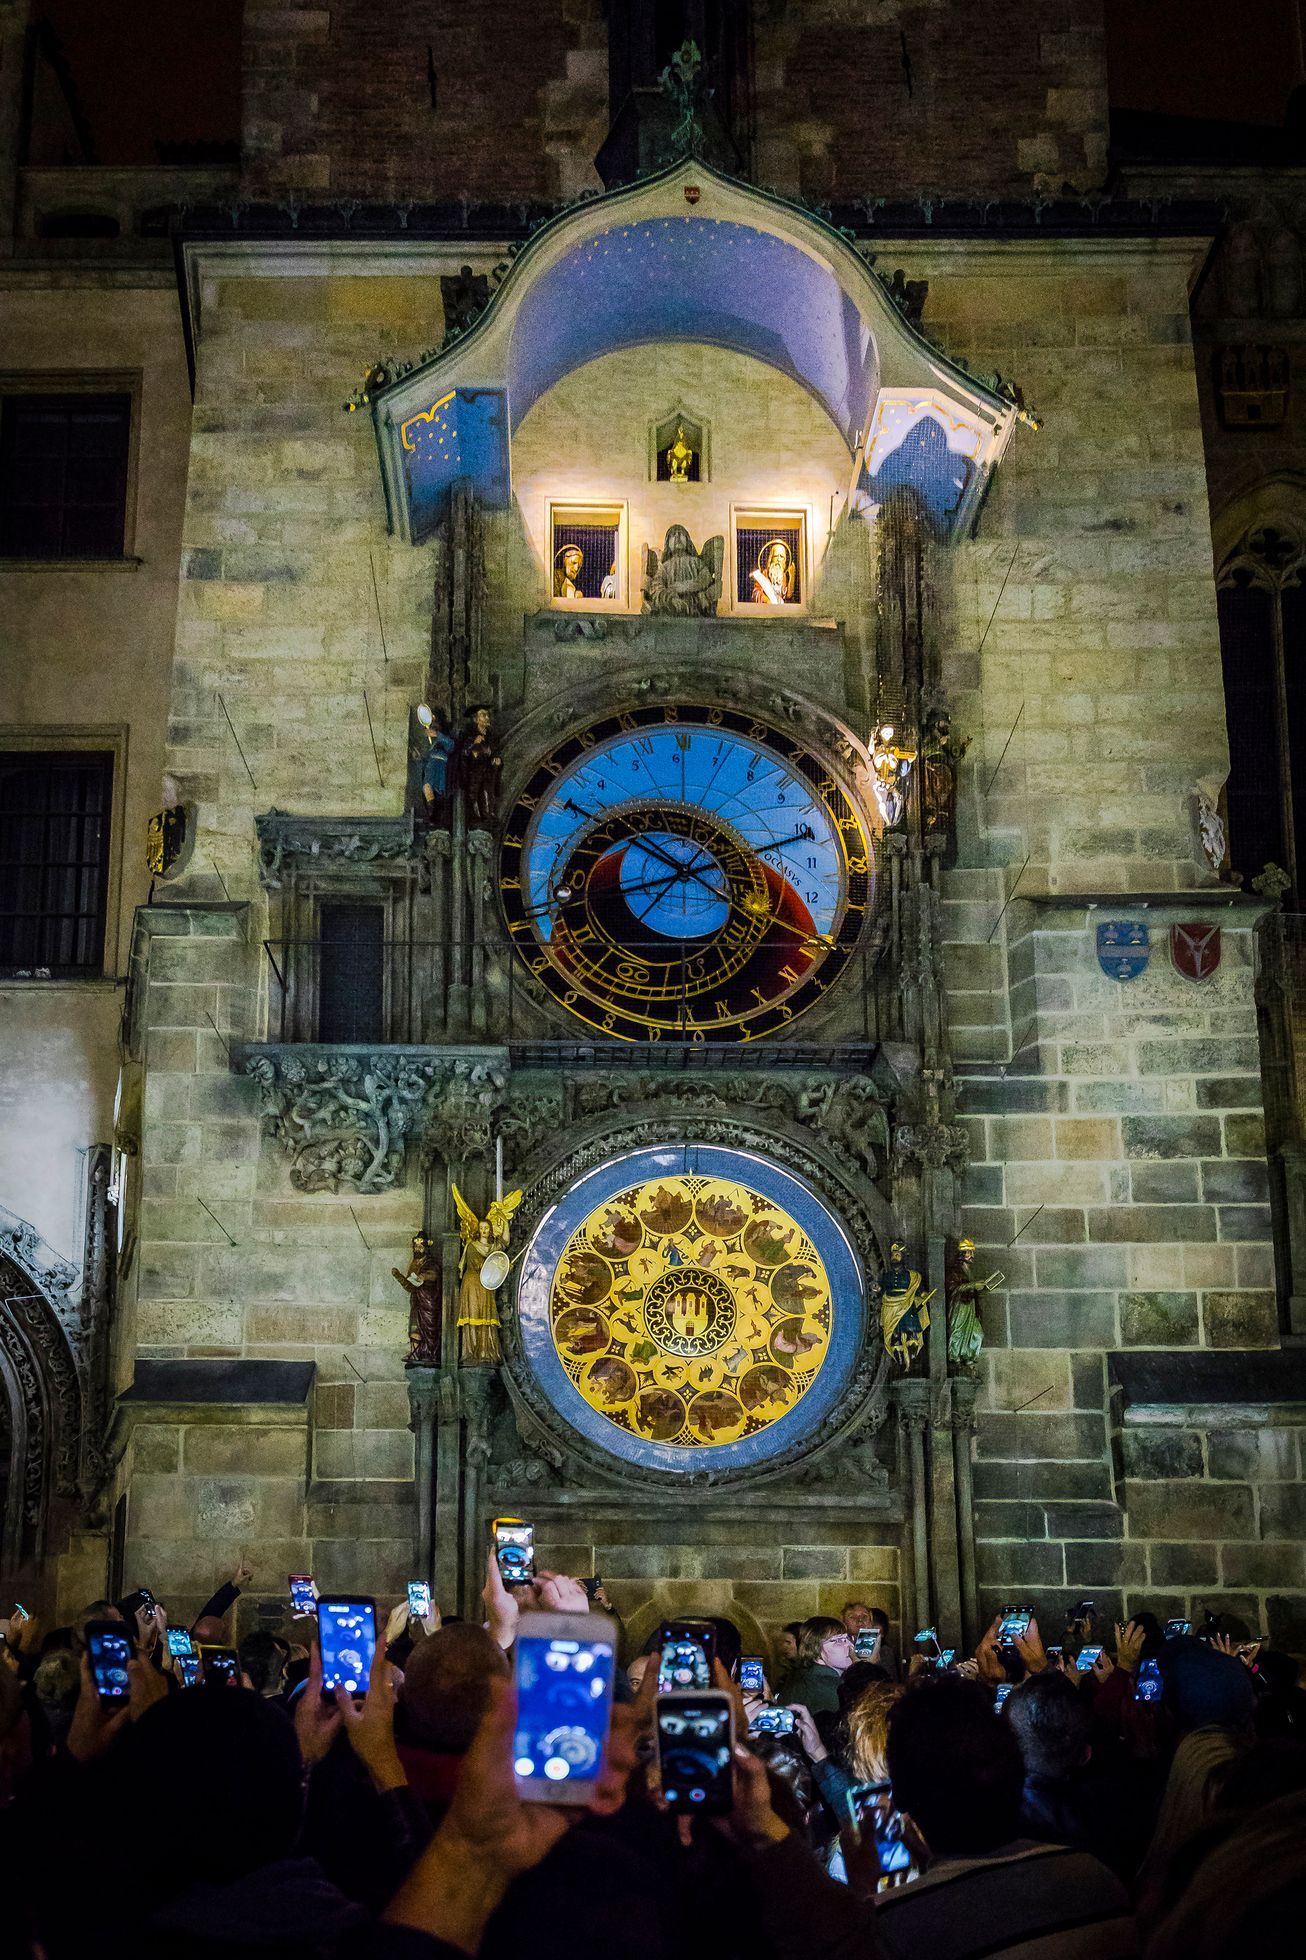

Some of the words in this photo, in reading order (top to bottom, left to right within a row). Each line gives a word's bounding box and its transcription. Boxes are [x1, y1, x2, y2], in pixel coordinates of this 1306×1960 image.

[672, 753, 680, 763] 6
[712, 756, 719, 767] 7
[632, 760, 639, 771] 5
[746, 770, 754, 781] 8
[597, 779, 606, 790] 4
[777, 793, 785, 804] 9
[794, 823, 808, 835] 10
[806, 857, 817, 869] 11
[805, 891, 819, 903] 12
